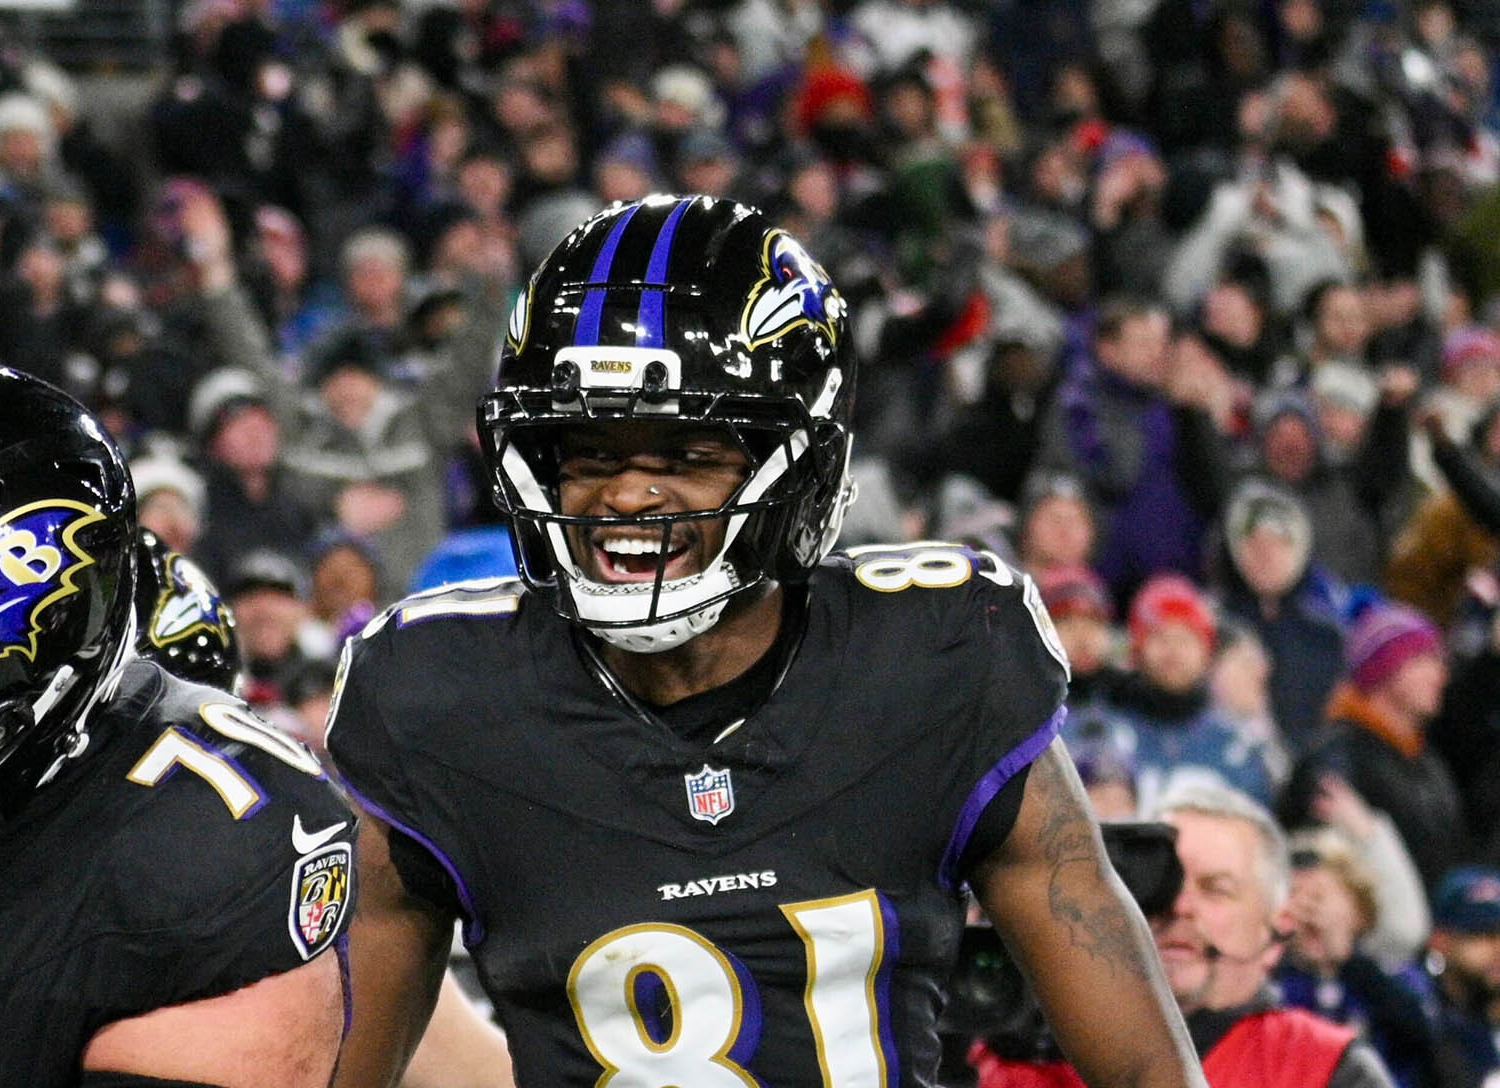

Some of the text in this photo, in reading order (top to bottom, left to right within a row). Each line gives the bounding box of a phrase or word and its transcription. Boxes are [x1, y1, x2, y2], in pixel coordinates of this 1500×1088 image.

[590, 360, 633, 373] RAVENS
[695, 791, 728, 814] NFL
[303, 853, 347, 877] RAVENS
[657, 870, 778, 900] RAVENS
